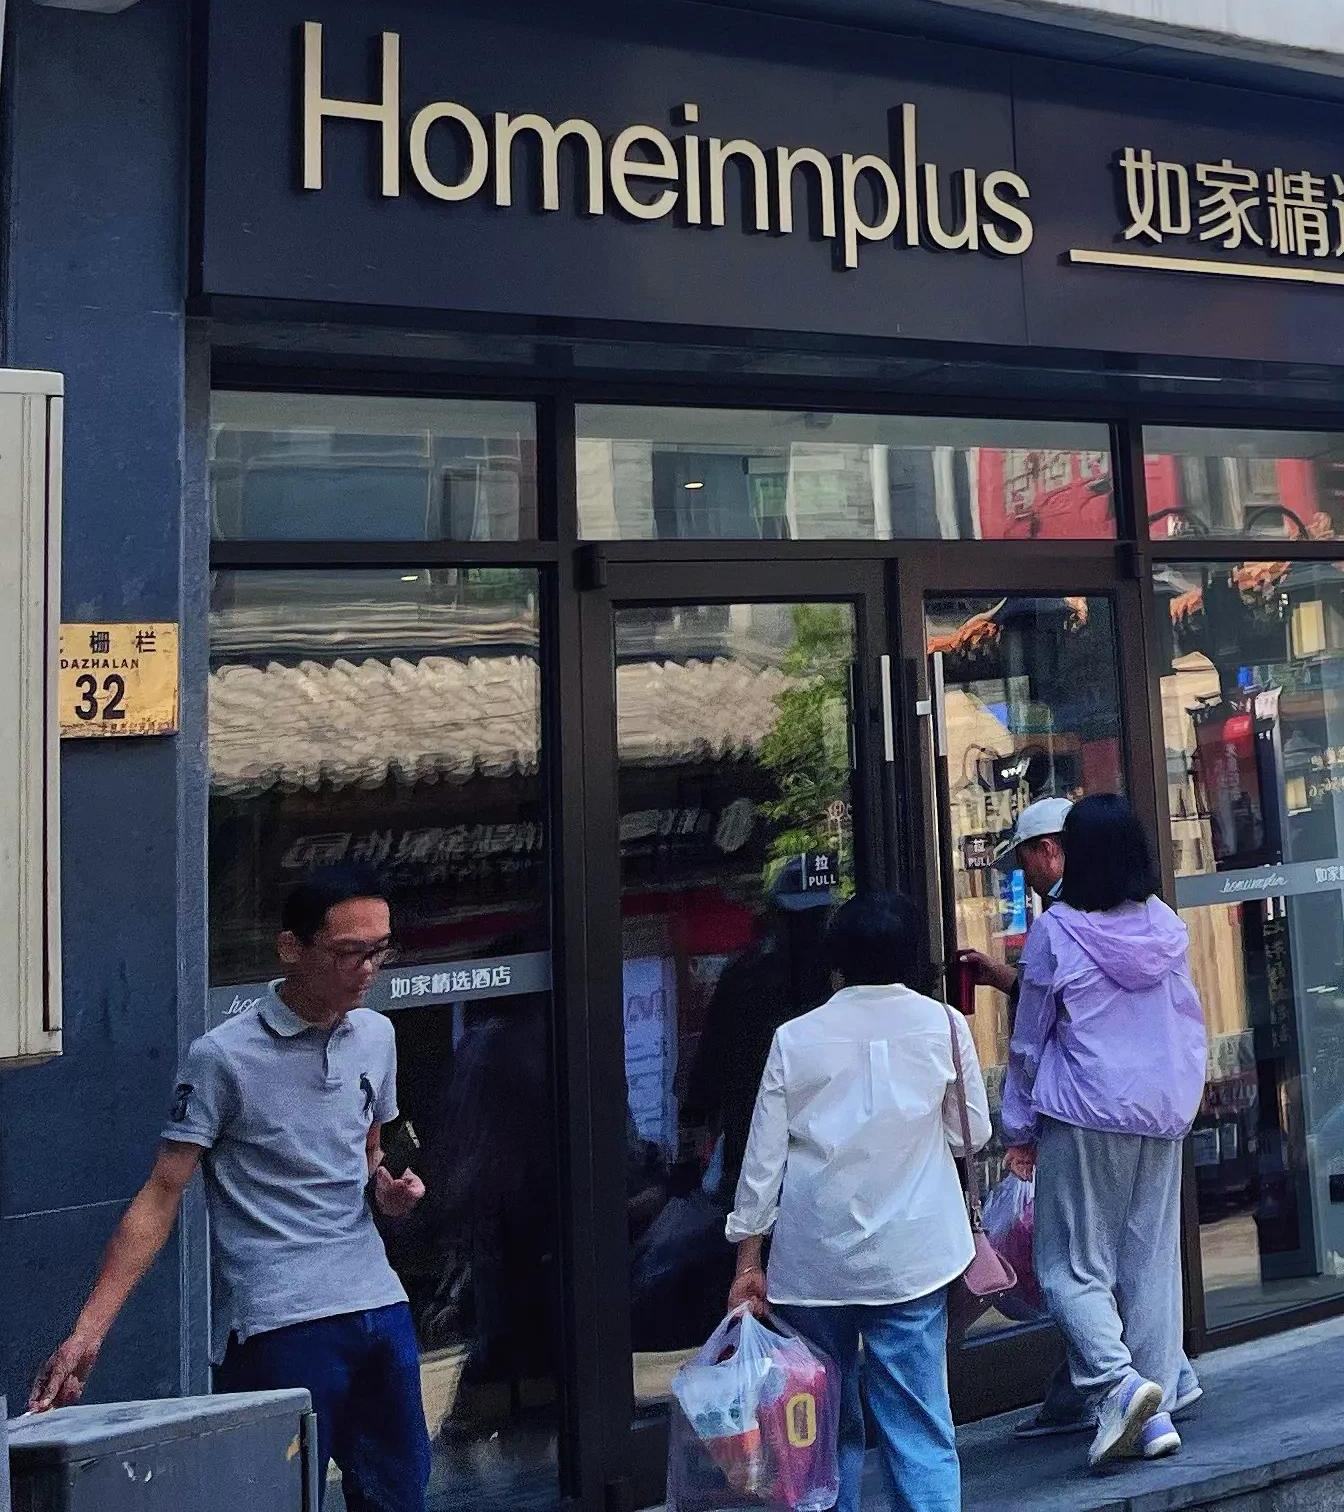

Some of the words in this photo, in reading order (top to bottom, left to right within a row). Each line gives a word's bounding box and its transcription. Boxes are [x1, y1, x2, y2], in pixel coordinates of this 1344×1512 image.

[302, 20, 1034, 269] Homeinnplus
[60, 630, 157, 654] 栅栏
[60, 658, 139, 669] DAZHALAN
[74, 673, 126, 720] 32
[815, 854, 829, 871] 拉
[808, 874, 837, 886] PULL
[390, 966, 512, 999] 如家精选酒店
